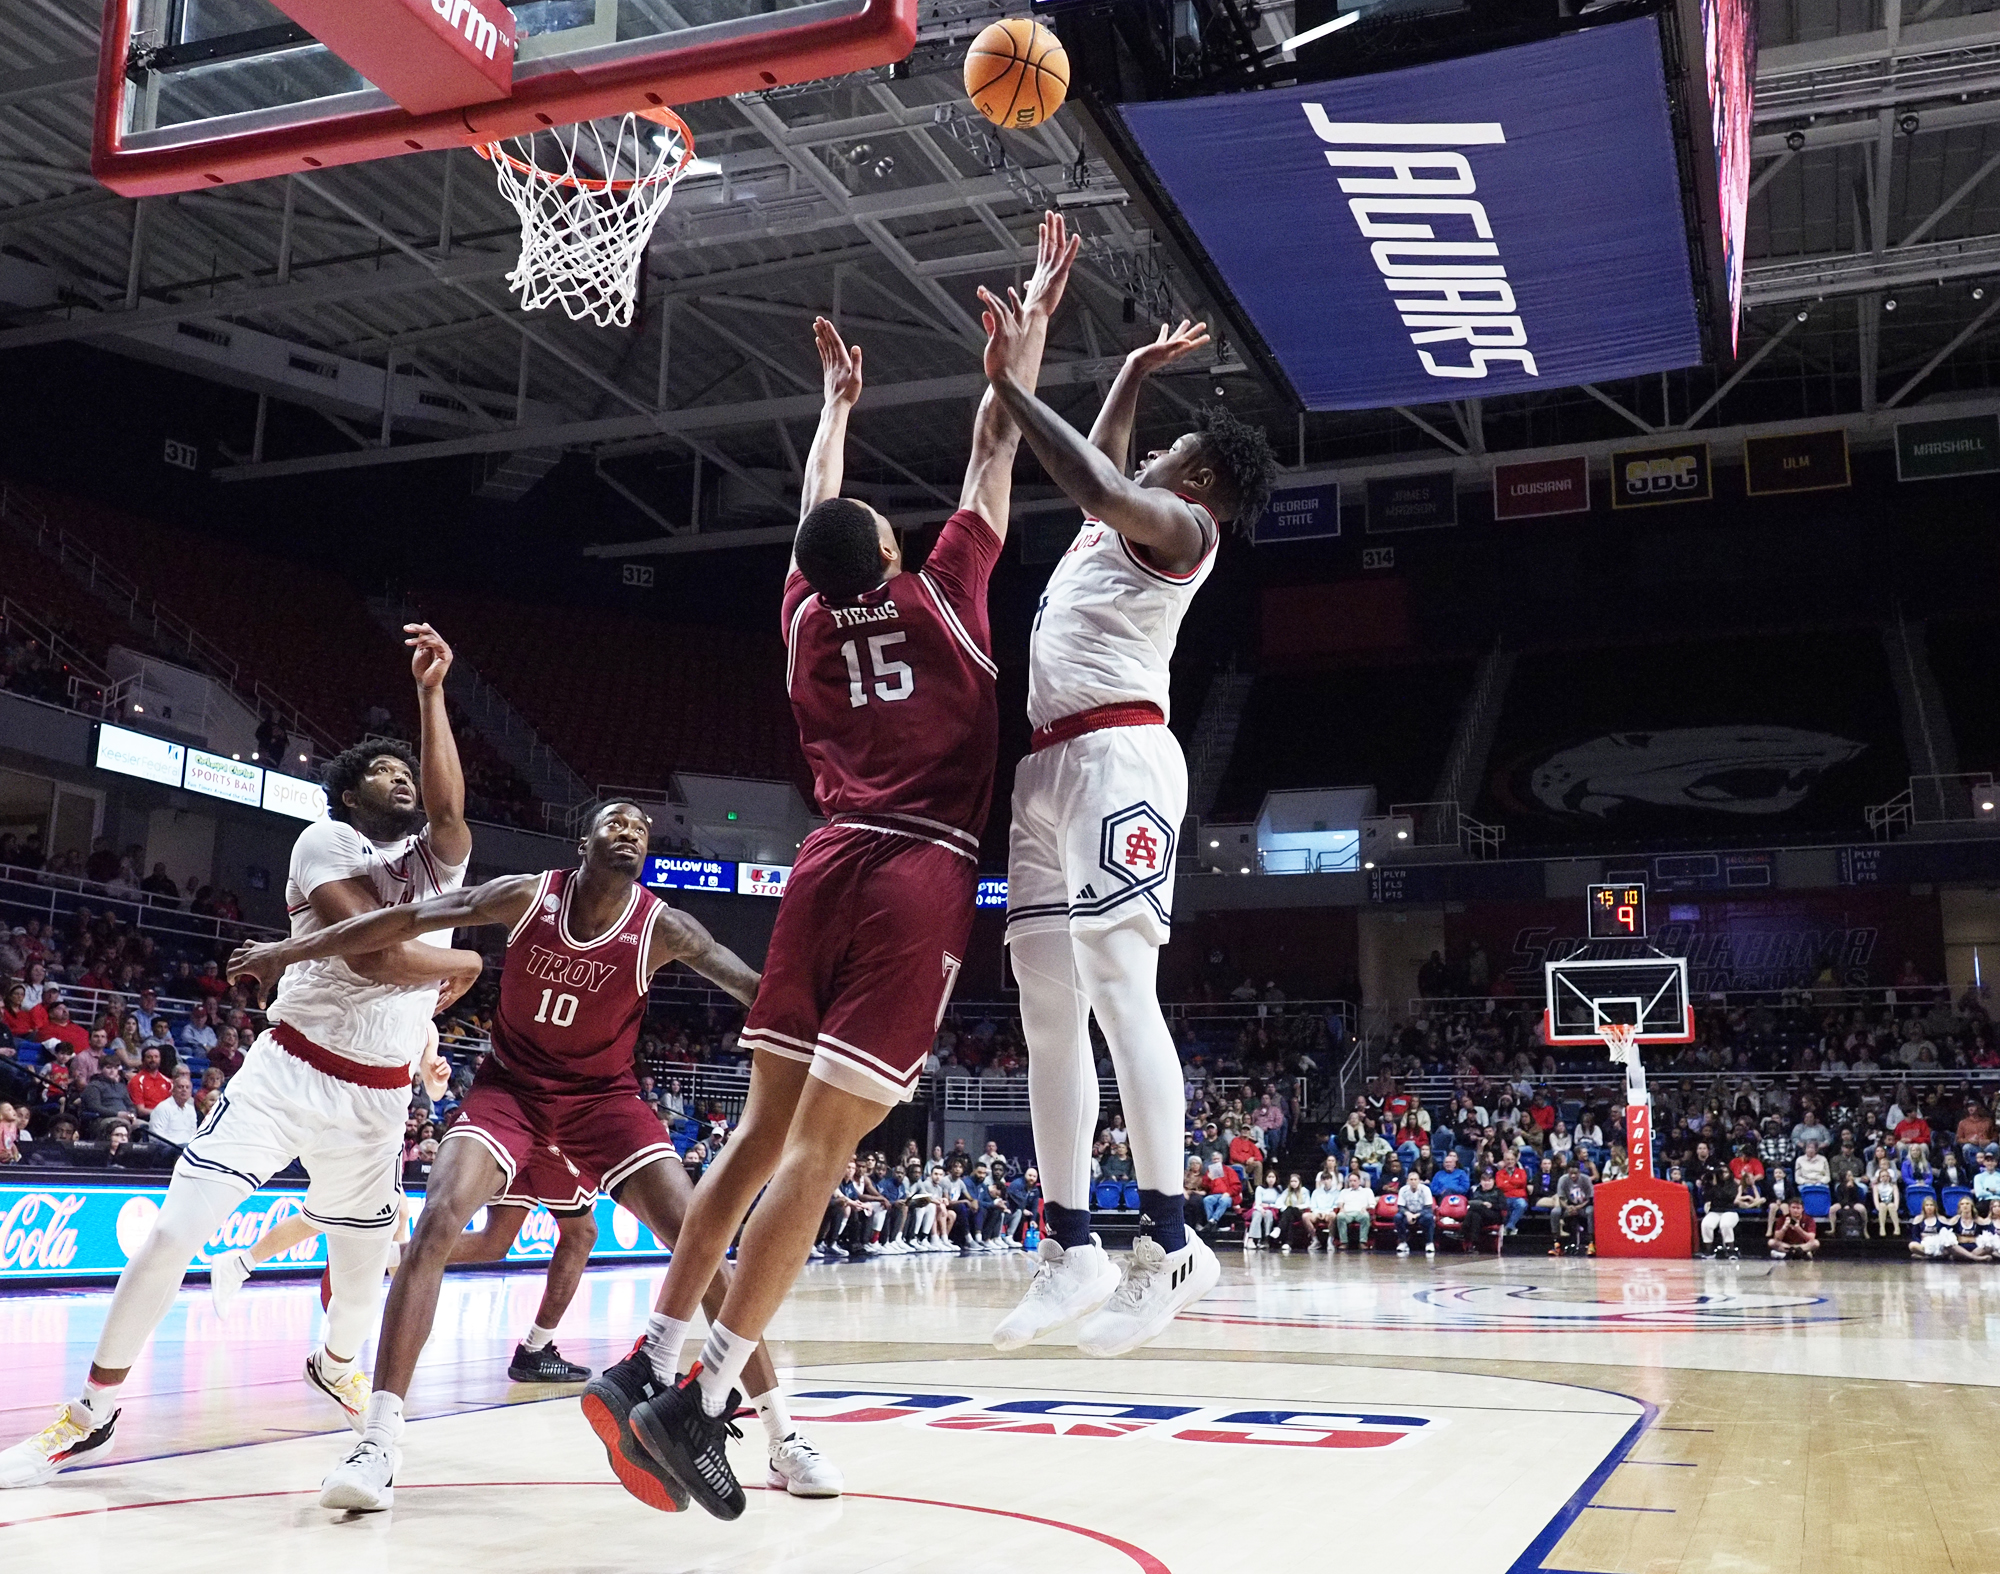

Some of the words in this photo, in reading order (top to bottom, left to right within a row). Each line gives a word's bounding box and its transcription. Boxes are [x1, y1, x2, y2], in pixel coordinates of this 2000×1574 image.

[1301, 102, 1539, 379] JAGUARS
[165, 443, 196, 467] 311
[1913, 438, 1985, 456] MARSHALL
[1782, 455, 1810, 469] ULM
[1625, 455, 1698, 495] SBC
[1510, 478, 1572, 496] LOUISIANA
[1272, 498, 1319, 513] GEORGIA
[1278, 513, 1314, 527] STATE
[1363, 552, 1394, 567] 314
[624, 566, 653, 584] 312
[831, 600, 900, 629] FIELDS
[841, 631, 915, 708] 15
[191, 767, 231, 787] SPORTS
[234, 779, 255, 793] BAR
[273, 783, 308, 806] spire
[655, 859, 702, 873] FOLLOW
[703, 863, 722, 874] US:
[1383, 870, 1407, 878] PLYR
[1385, 891, 1403, 899] PTS
[1624, 890, 1638, 905] 10
[1618, 906, 1634, 932] 9
[618, 932, 639, 946] SBC
[526, 945, 617, 992] TROY
[534, 988, 579, 1028] 10
[1629, 1210, 1652, 1232] pf
